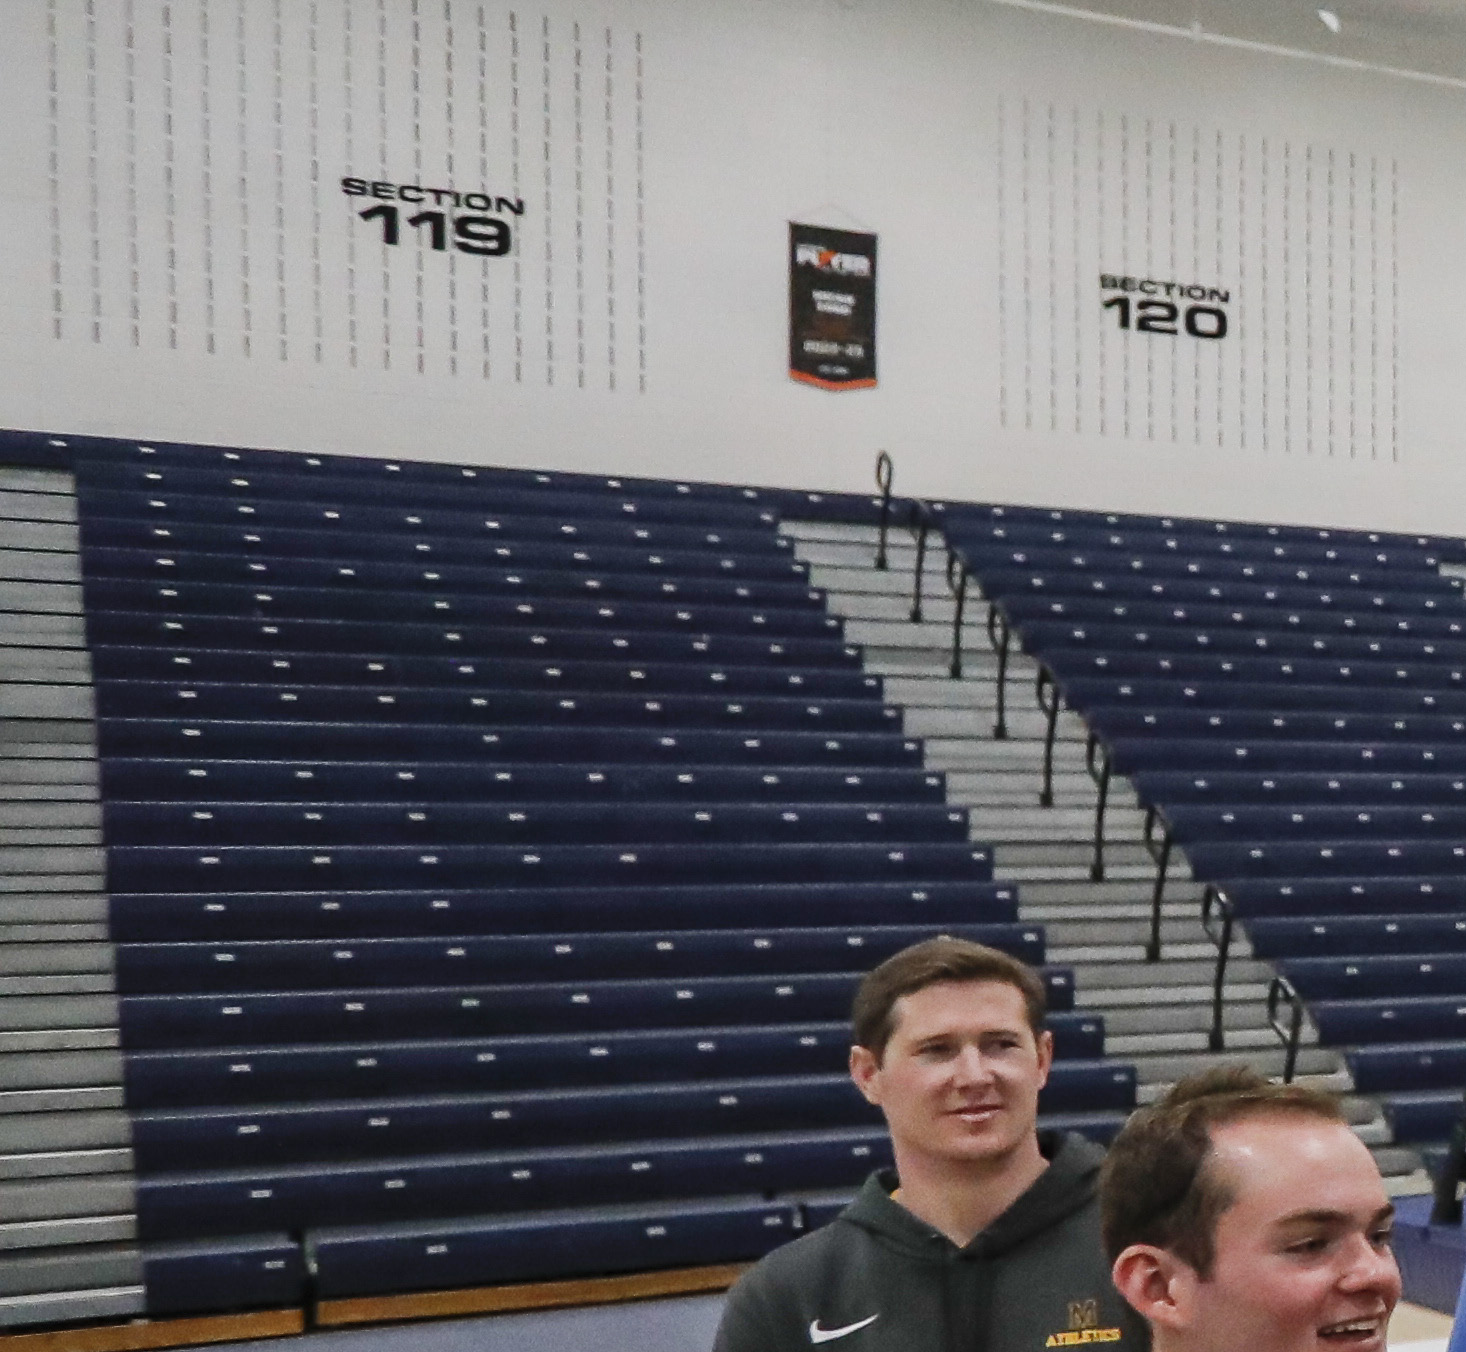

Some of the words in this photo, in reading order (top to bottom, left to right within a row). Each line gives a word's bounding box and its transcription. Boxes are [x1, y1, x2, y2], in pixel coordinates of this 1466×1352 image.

[341, 177, 525, 216] SECTION
[358, 204, 511, 256] 119
[1100, 273, 1231, 303] SECTION
[1103, 295, 1228, 339] 120
